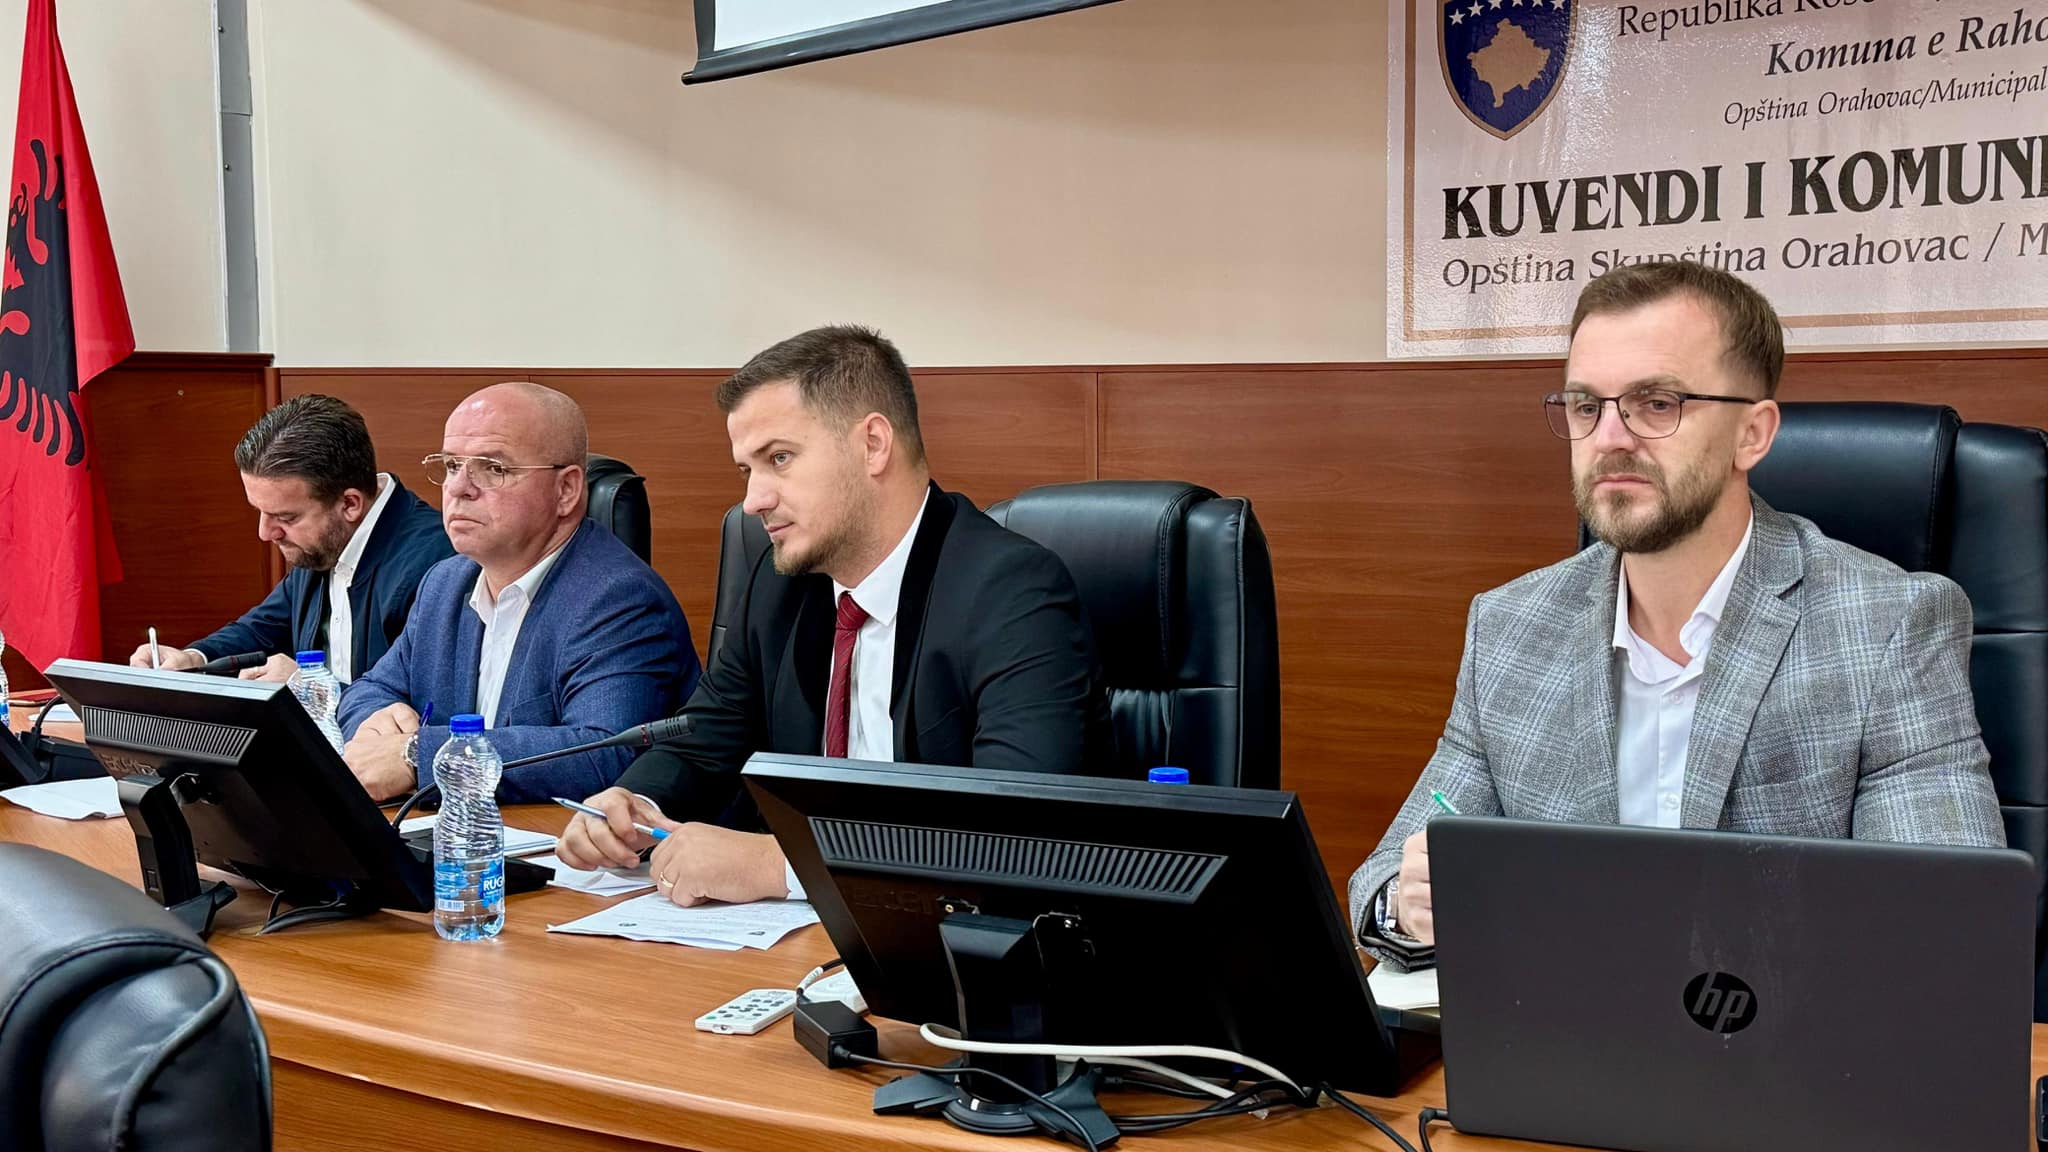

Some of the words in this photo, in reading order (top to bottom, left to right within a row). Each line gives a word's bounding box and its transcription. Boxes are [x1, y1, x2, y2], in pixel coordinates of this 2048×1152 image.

[1617, 0, 1783, 42] Republika
[1764, 34, 1917, 76] Komuna
[1927, 31, 1945, 56] e
[1724, 98, 1809, 130] Opština
[1817, 65, 2048, 116] Orahovac/Municipal
[1442, 165, 1723, 240] KUVENDI
[1744, 161, 1767, 220] I
[1442, 253, 1575, 294] Opština
[1781, 233, 1970, 270] Orahovac
[1692, 971, 1750, 1034] hp
